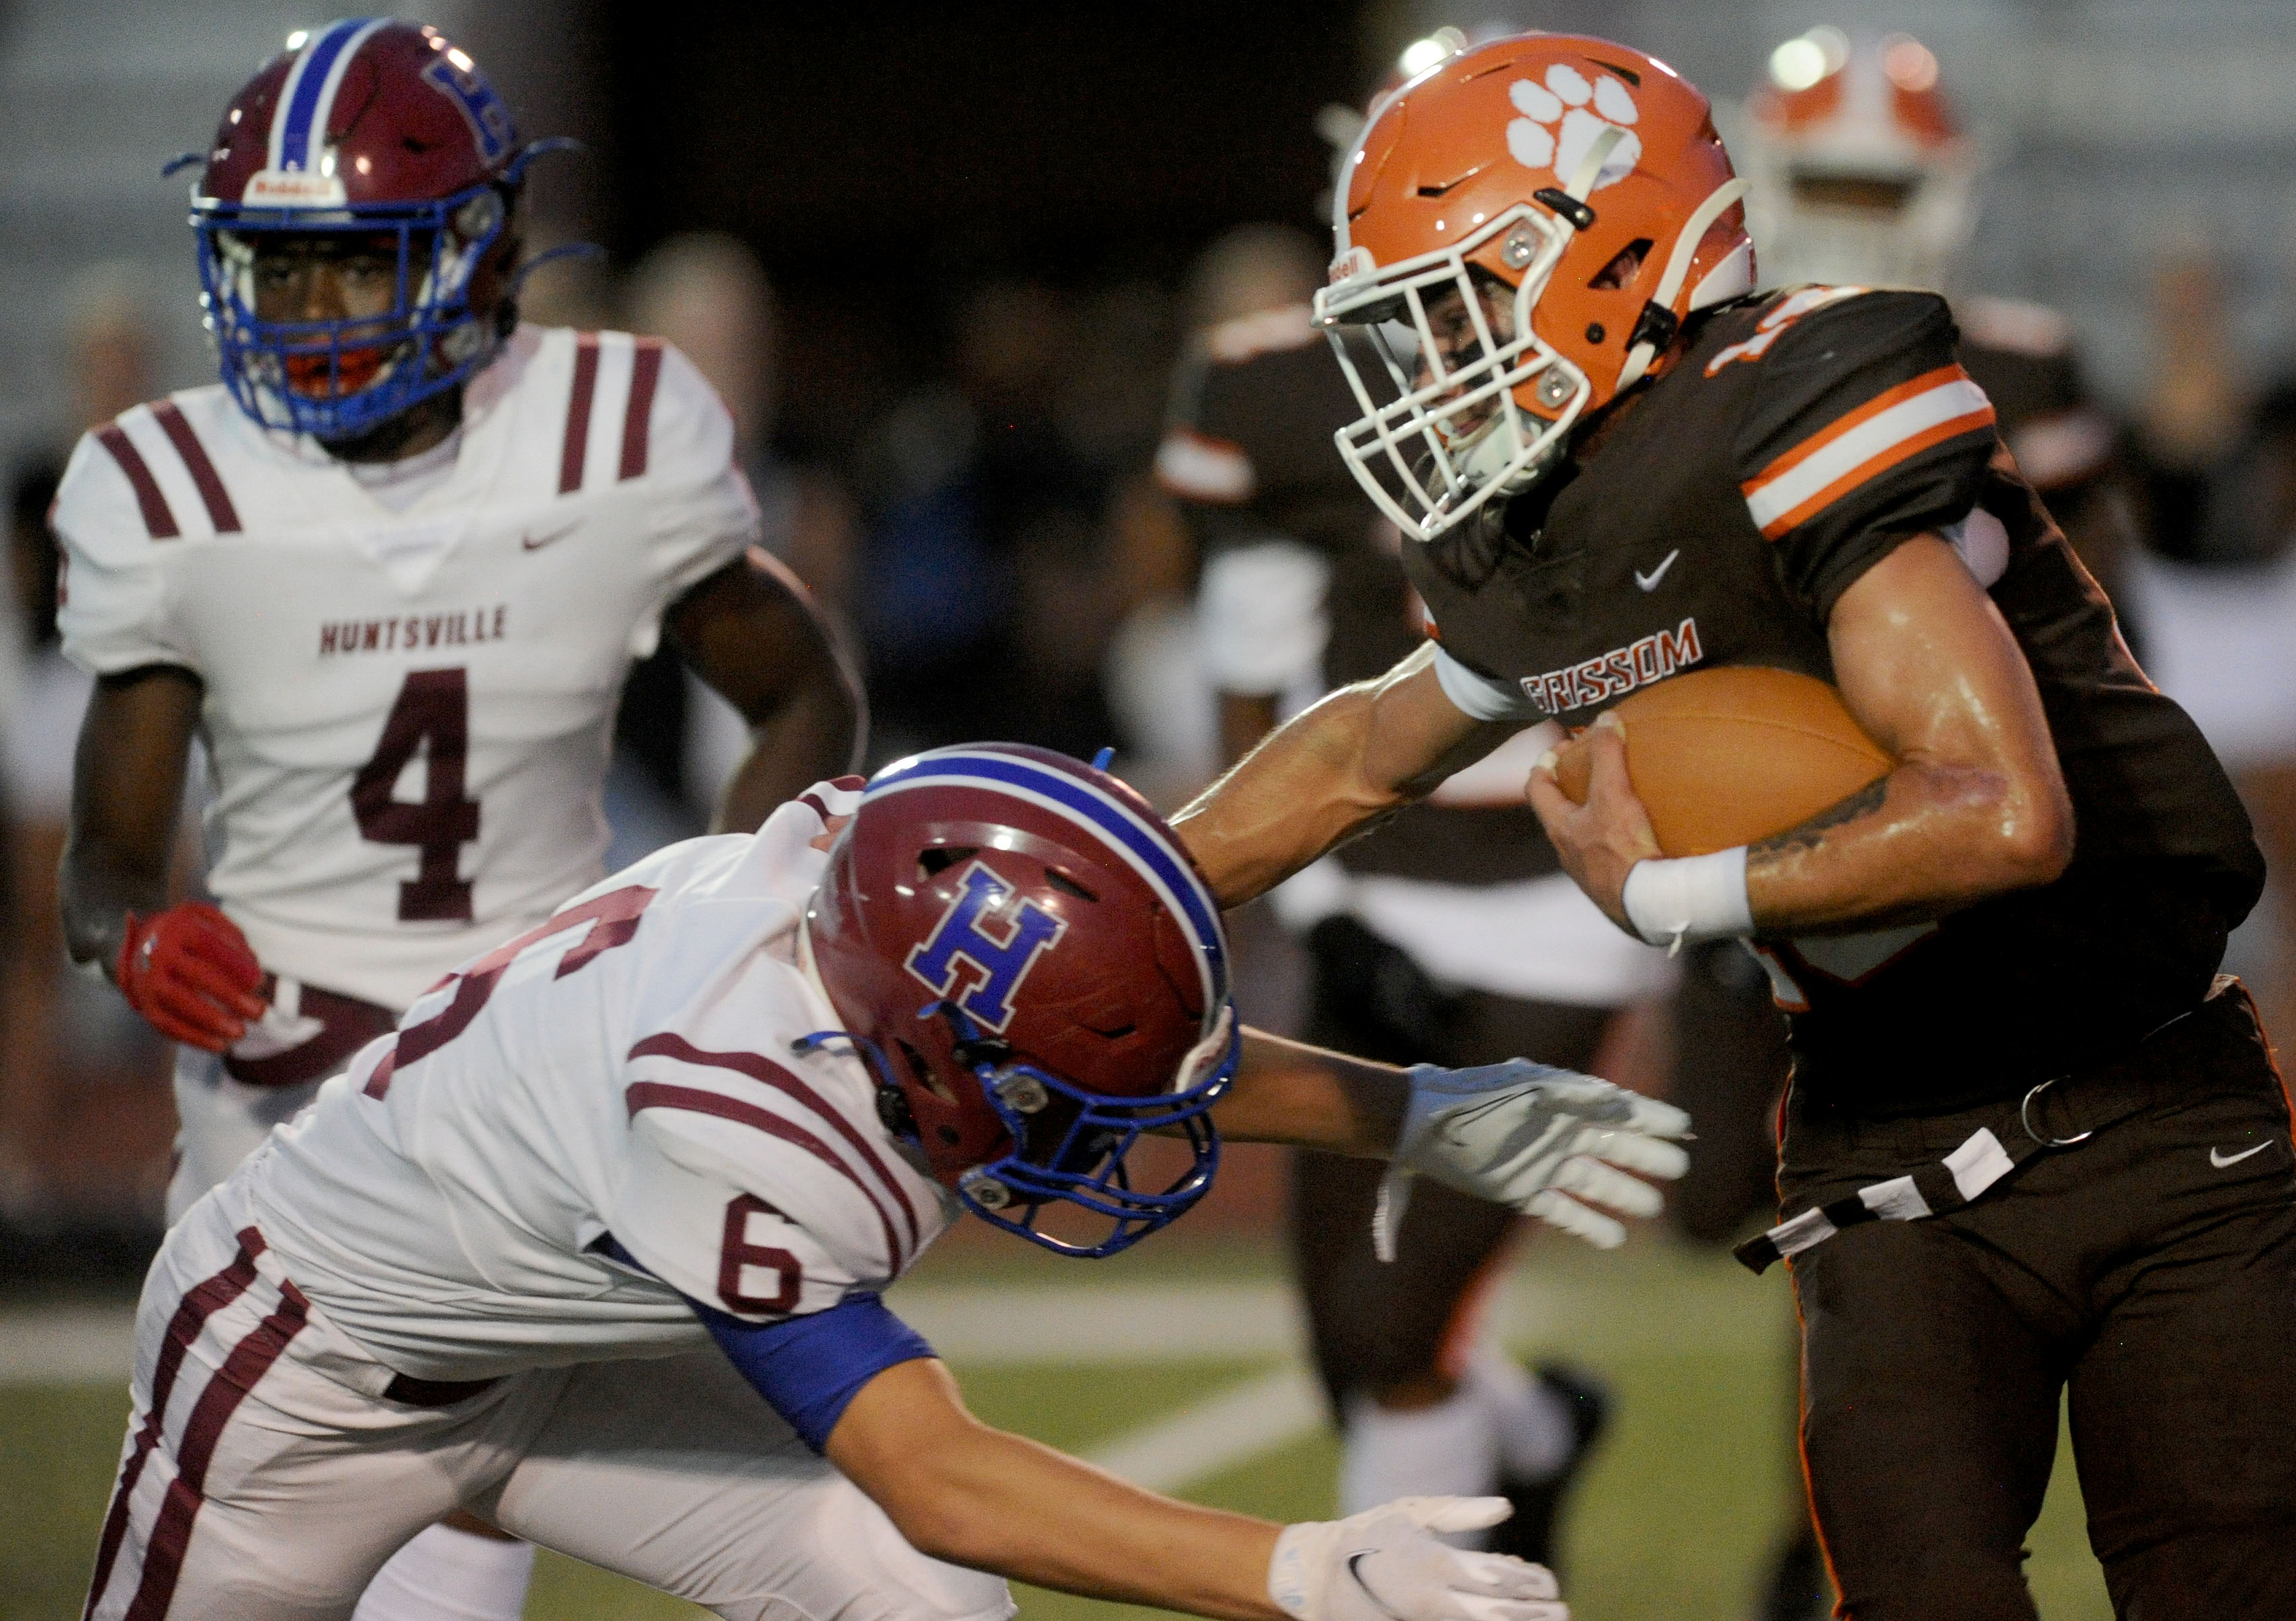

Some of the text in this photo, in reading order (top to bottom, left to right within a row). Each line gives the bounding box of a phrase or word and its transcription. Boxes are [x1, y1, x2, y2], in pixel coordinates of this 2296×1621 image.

[319, 605, 507, 656] HUNTSVILLE
[347, 667, 480, 921] 4
[904, 860, 1070, 1034] H
[716, 1192, 803, 1315] 6
